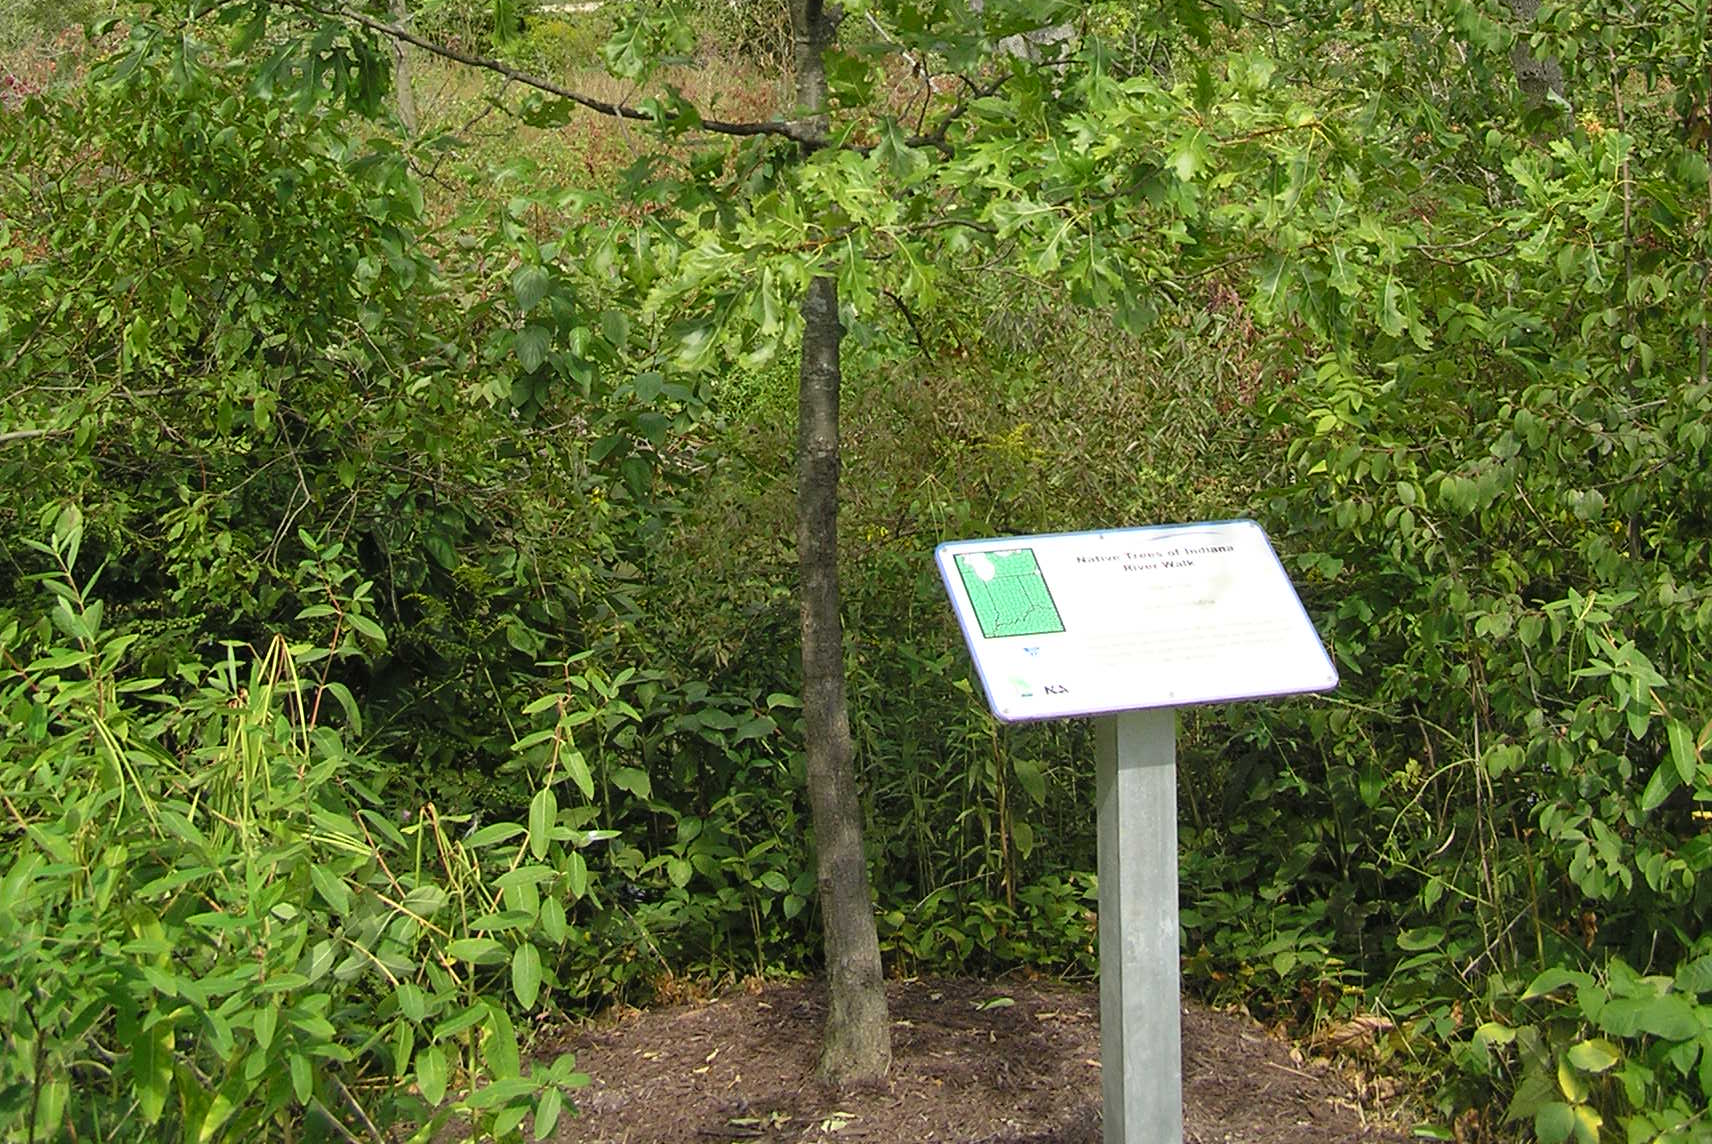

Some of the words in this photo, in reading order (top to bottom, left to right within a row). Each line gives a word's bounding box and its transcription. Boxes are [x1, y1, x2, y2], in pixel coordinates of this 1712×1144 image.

[1075, 555, 1121, 564] Native
[1126, 551, 1163, 560] Trees
[1167, 548, 1180, 557] of
[1184, 544, 1235, 556] Indiana
[1122, 562, 1158, 572] River
[1161, 558, 1195, 569] Walk
